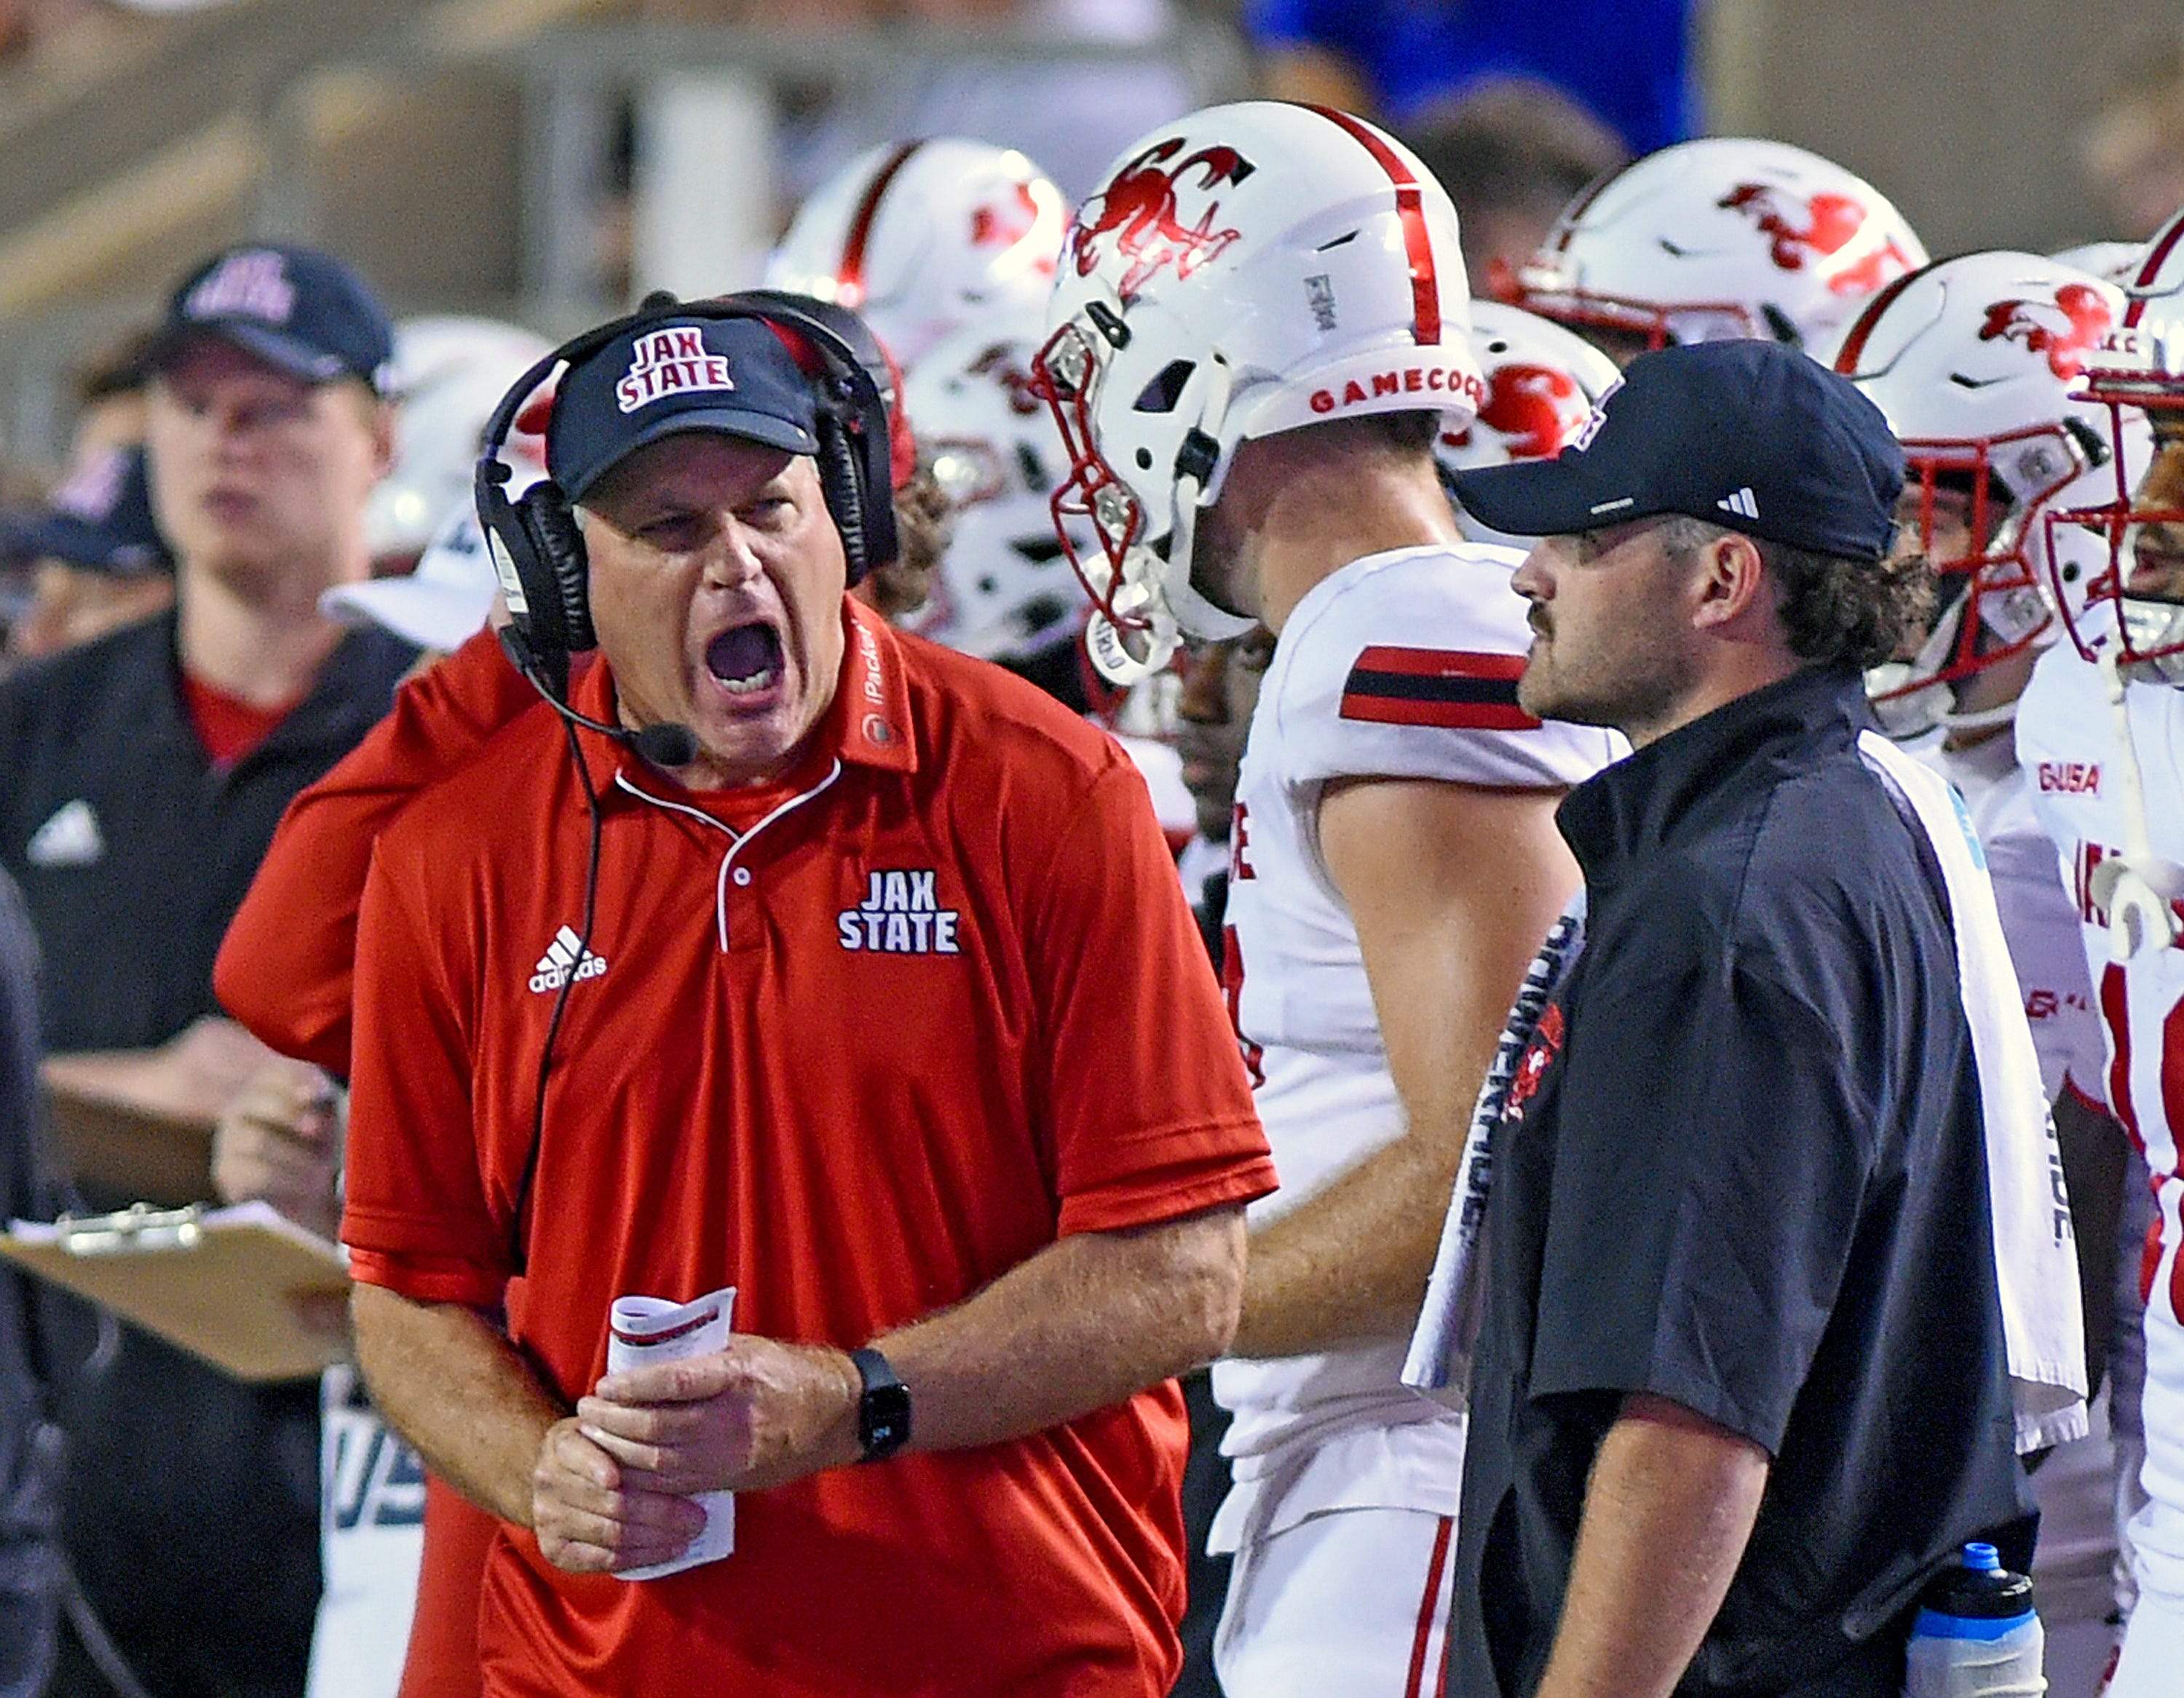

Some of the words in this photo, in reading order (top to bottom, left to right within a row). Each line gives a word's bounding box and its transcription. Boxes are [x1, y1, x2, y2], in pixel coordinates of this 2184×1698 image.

[636, 330, 703, 371] JAX
[620, 358, 729, 409] STATE
[859, 869, 938, 912] JAX
[837, 910, 961, 953] STATE
[528, 955, 608, 993] adias
